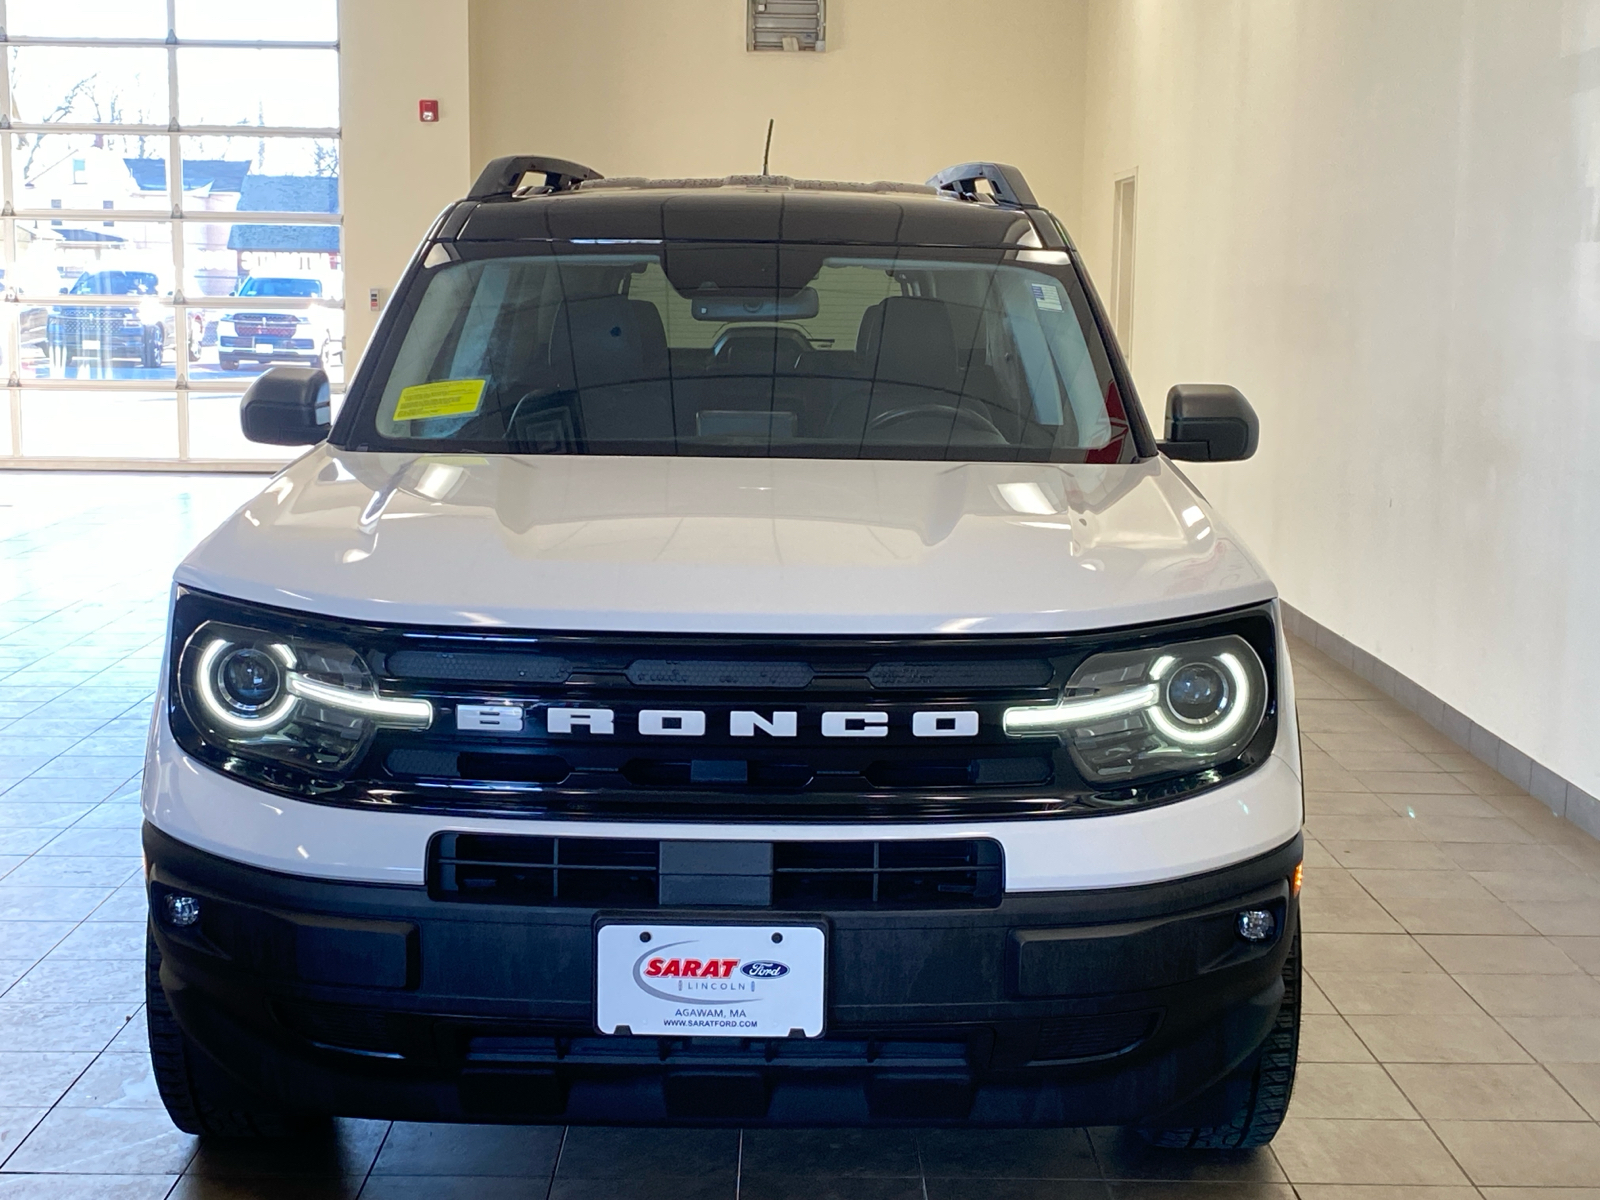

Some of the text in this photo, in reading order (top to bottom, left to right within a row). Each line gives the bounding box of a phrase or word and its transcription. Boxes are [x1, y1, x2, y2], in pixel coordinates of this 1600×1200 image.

[455, 703, 980, 738] BRONCO
[645, 957, 781, 979] SARAT Ford
[687, 982, 746, 991] LINCOLN
[675, 1009, 747, 1019] AGAWAM, MA
[663, 1019, 758, 1028] WWW.SARATFORD.COM
